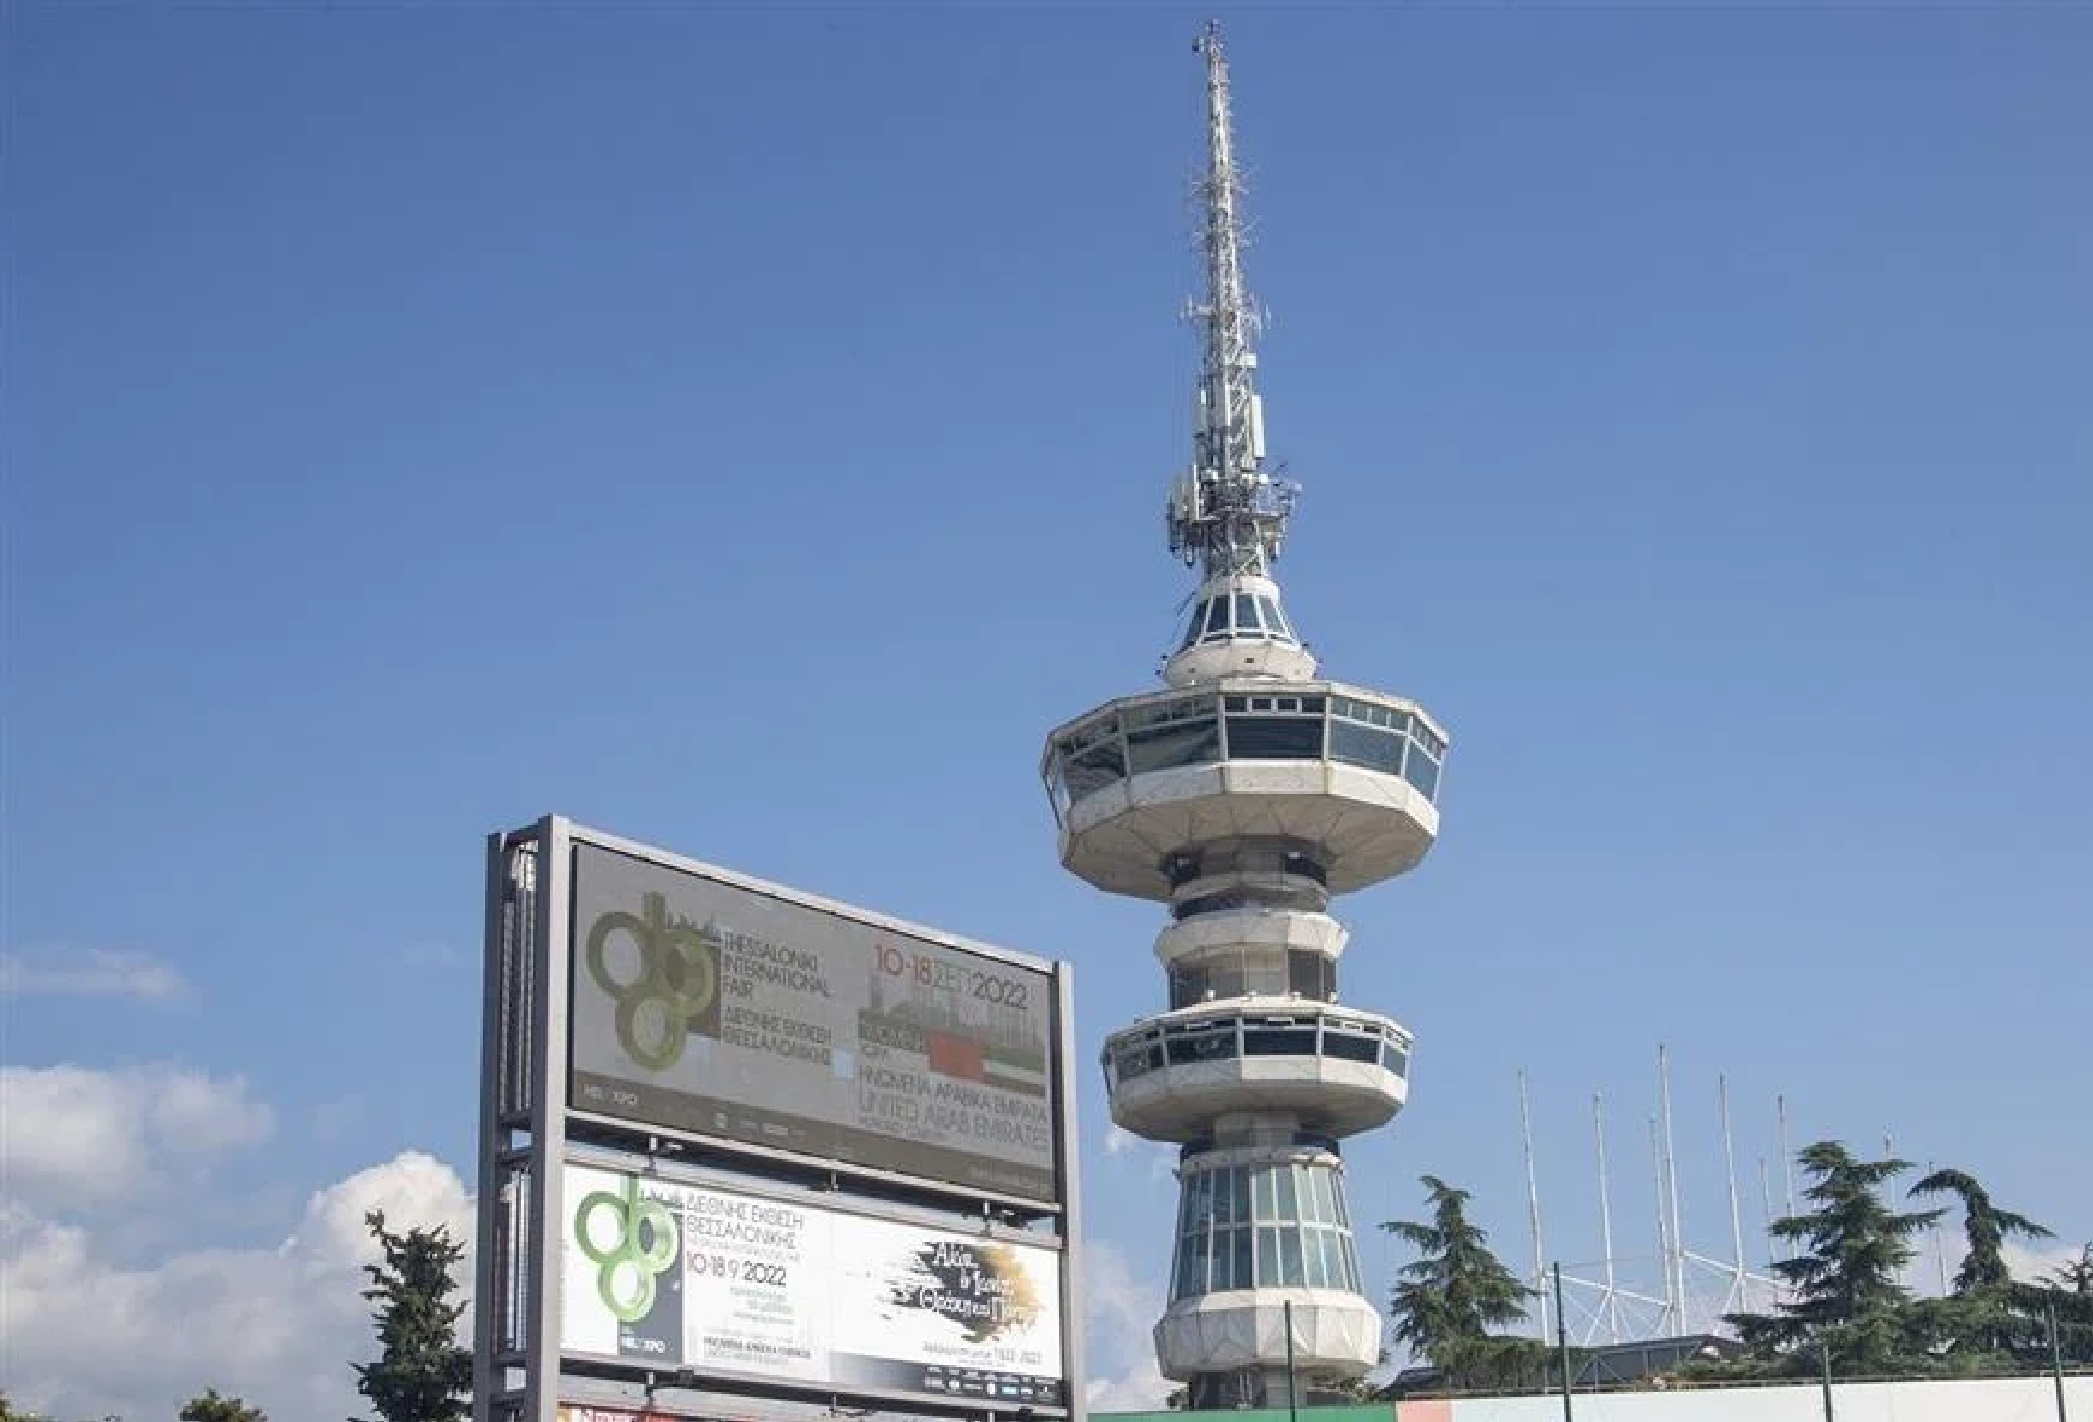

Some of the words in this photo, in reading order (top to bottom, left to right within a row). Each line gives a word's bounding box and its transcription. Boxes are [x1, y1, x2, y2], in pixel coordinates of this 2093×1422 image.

[723, 954, 831, 998] INTERNATIONAL
[723, 975, 754, 1001] FAIR
[972, 970, 1028, 1010] 2022
[742, 1259, 788, 1287] 2022
